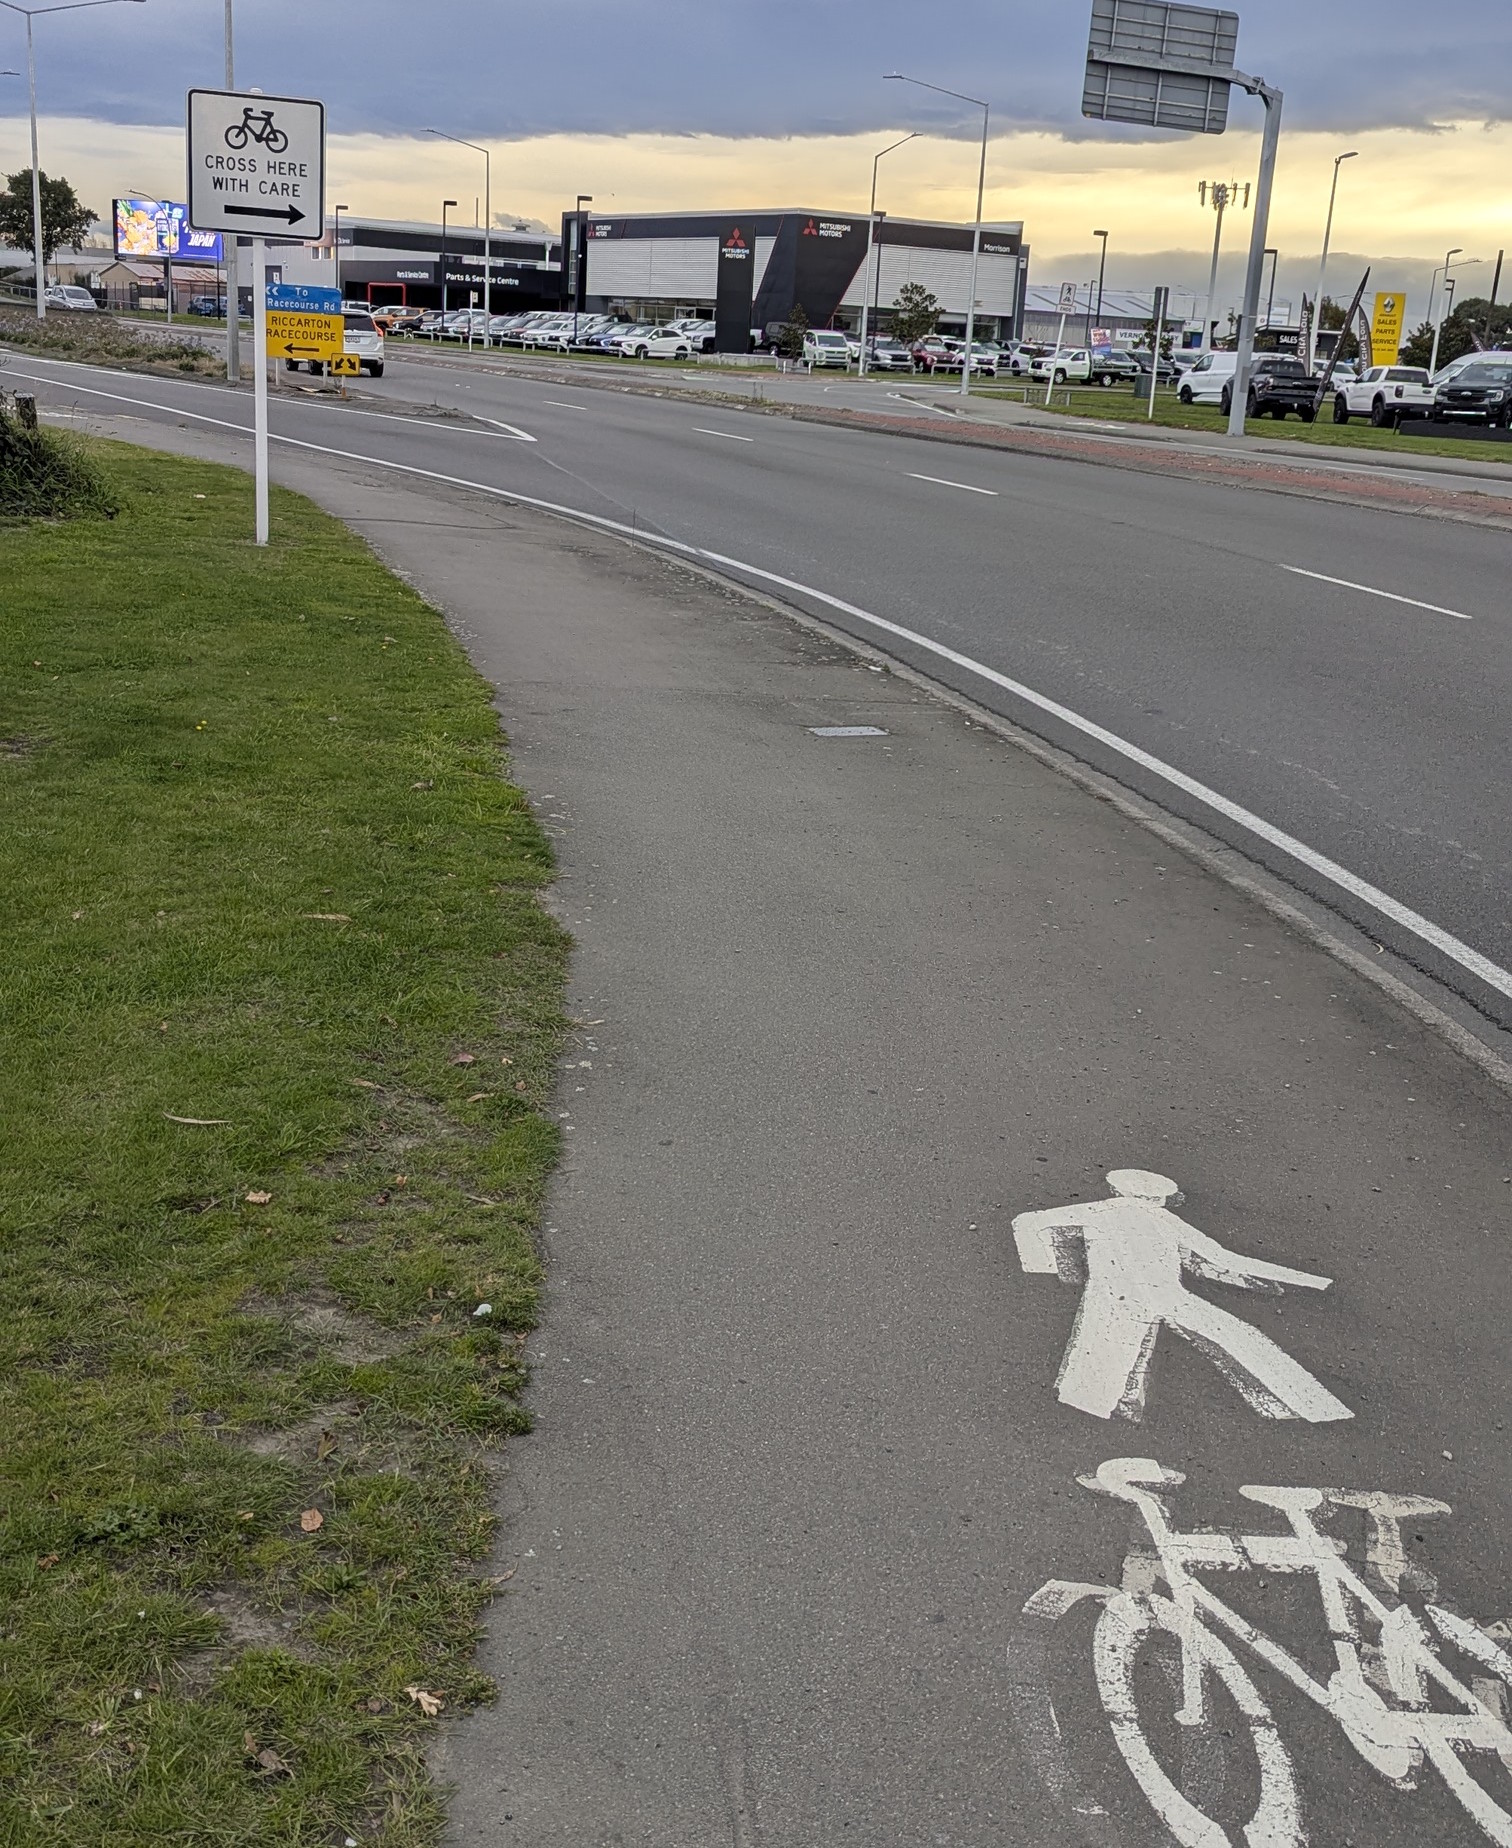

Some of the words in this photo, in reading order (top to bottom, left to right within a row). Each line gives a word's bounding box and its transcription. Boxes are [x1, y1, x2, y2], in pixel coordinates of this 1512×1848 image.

[205, 154, 257, 173] CROSS
[267, 160, 308, 178] HERE
[212, 176, 249, 193] WITH
[258, 180, 301, 198] CARE
[820, 222, 851, 232] MITSUBISHI
[819, 229, 843, 238] MOTORS
[188, 233, 216, 248] JAPAN
[984, 243, 1011, 253] Morrison
[446, 272, 464, 281] Parts
[472, 274, 496, 284] Servce
[497, 276, 520, 286] Centre
[295, 287, 309, 297] To
[267, 297, 320, 310] Racecourse
[323, 301, 335, 311] Rd
[271, 316, 331, 329] RICCARTON
[1377, 318, 1397, 326] SALES
[265, 328, 337, 342] RACECOURSE
[1279, 334, 1298, 345] SALES
[1372, 338, 1397, 346] SERVICE
